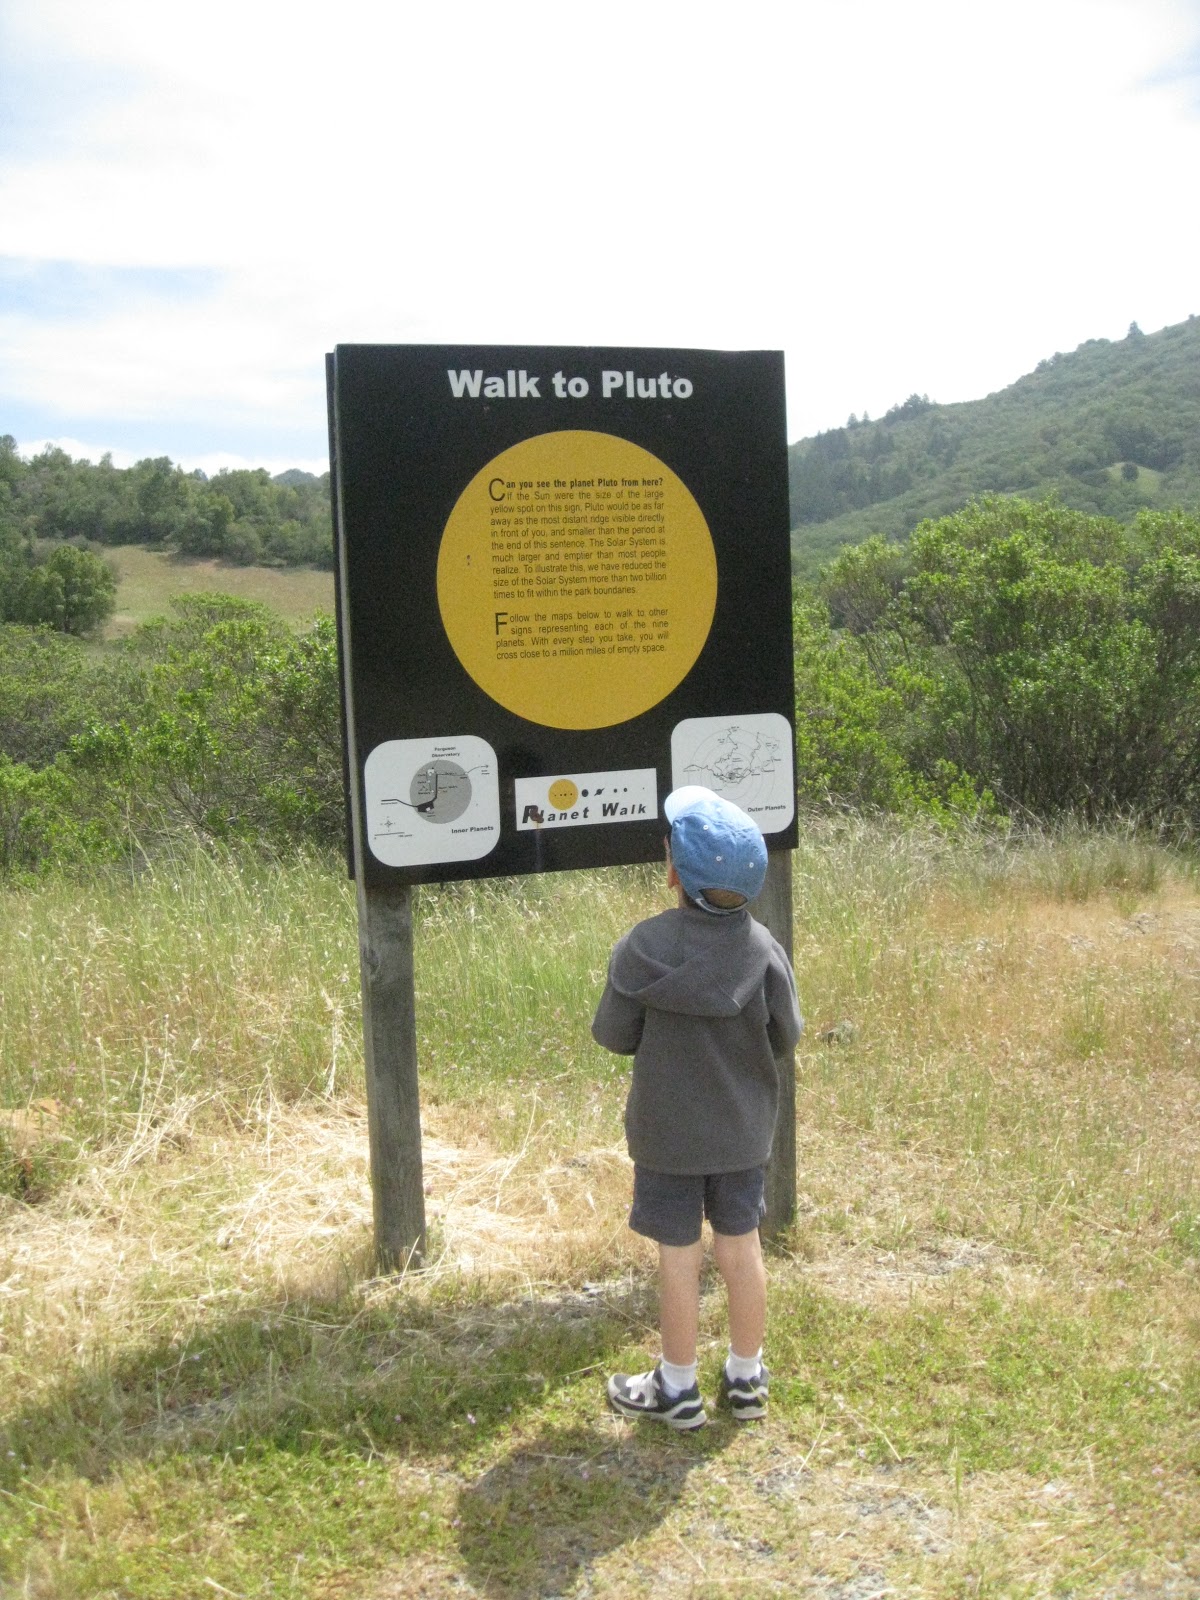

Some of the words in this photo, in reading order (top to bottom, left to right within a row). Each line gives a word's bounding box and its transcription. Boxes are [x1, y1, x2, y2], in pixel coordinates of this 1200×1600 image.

[448, 370, 541, 398] Walk
[552, 372, 589, 398] to
[602, 370, 693, 399] Pluto
[520, 480, 533, 489] you
[554, 479, 566, 487] the
[570, 479, 594, 488] planet
[598, 479, 617, 487] Pluto
[621, 478, 638, 486] from
[642, 478, 663, 486] here?
[507, 492, 512, 500] If
[517, 491, 530, 500] the
[535, 492, 550, 500] Sun
[579, 490, 591, 499] the
[596, 490, 611, 498] size
[616, 490, 623, 498] of
[628, 490, 640, 498] the
[645, 490, 663, 499] large
[490, 504, 514, 514] yellow
[517, 505, 534, 513] spot
[549, 503, 562, 512] this
[585, 503, 604, 511] Pluto
[607, 502, 628, 510] would
[632, 502, 640, 510] be
[655, 501, 664, 509] far
[491, 518, 510, 526] away
[526, 516, 538, 524] the
[541, 516, 559, 524] most
[562, 515, 588, 523] distant
[591, 515, 609, 524] ridge
[612, 514, 635, 522] visible
[638, 514, 664, 523] directly
[491, 529, 497, 537] in
[501, 529, 518, 537] front
[522, 528, 529, 536] of
[551, 528, 565, 536] and
[568, 527, 595, 535] smaller
[598, 526, 614, 535] than
[618, 526, 629, 534] the
[632, 525, 655, 535] period
[507, 541, 521, 549] end
[524, 540, 531, 548] of
[534, 540, 546, 548] this
[590, 539, 604, 547] The
[607, 538, 626, 546] Solar
[629, 537, 656, 547] System
[492, 553, 514, 562] much
[519, 553, 540, 562] larger
[545, 552, 559, 560] and
[564, 551, 592, 561] emptier
[597, 551, 613, 559] than
[641, 550, 665, 558] people
[525, 565, 532, 573] To
[602, 562, 619, 570] have
[622, 562, 652, 570] reduced
[655, 561, 666, 569] the
[494, 578, 509, 587] size
[522, 577, 533, 585] the
[536, 576, 556, 585] Solar
[559, 575, 587, 585] System
[589, 575, 608, 583] more
[611, 574, 627, 582] than
[646, 572, 666, 581] billion
[494, 590, 515, 599] times
[517, 590, 525, 598] to
[536, 588, 558, 597] within
[561, 587, 572, 596] the
[575, 587, 591, 596] park
[552, 614, 572, 622] maps
[578, 612, 599, 620] below
[616, 610, 632, 618] walk
[649, 608, 668, 616] other
[511, 626, 532, 635] signs
[539, 623, 588, 633] representing
[595, 622, 613, 630] each
[620, 621, 627, 629] of
[634, 620, 645, 629] the
[653, 619, 668, 627] nine
[532, 637, 548, 645] With
[553, 637, 574, 646] every
[579, 635, 594, 644] step
[600, 635, 612, 643] you
[640, 633, 653, 642] you
[497, 652, 517, 660] cross
[520, 650, 540, 658] close
[542, 649, 550, 657] to
[560, 648, 583, 656] million
[586, 646, 605, 655] miles
[608, 645, 615, 654] of
[618, 645, 639, 655] empty
[602, 802, 647, 817] Walk
